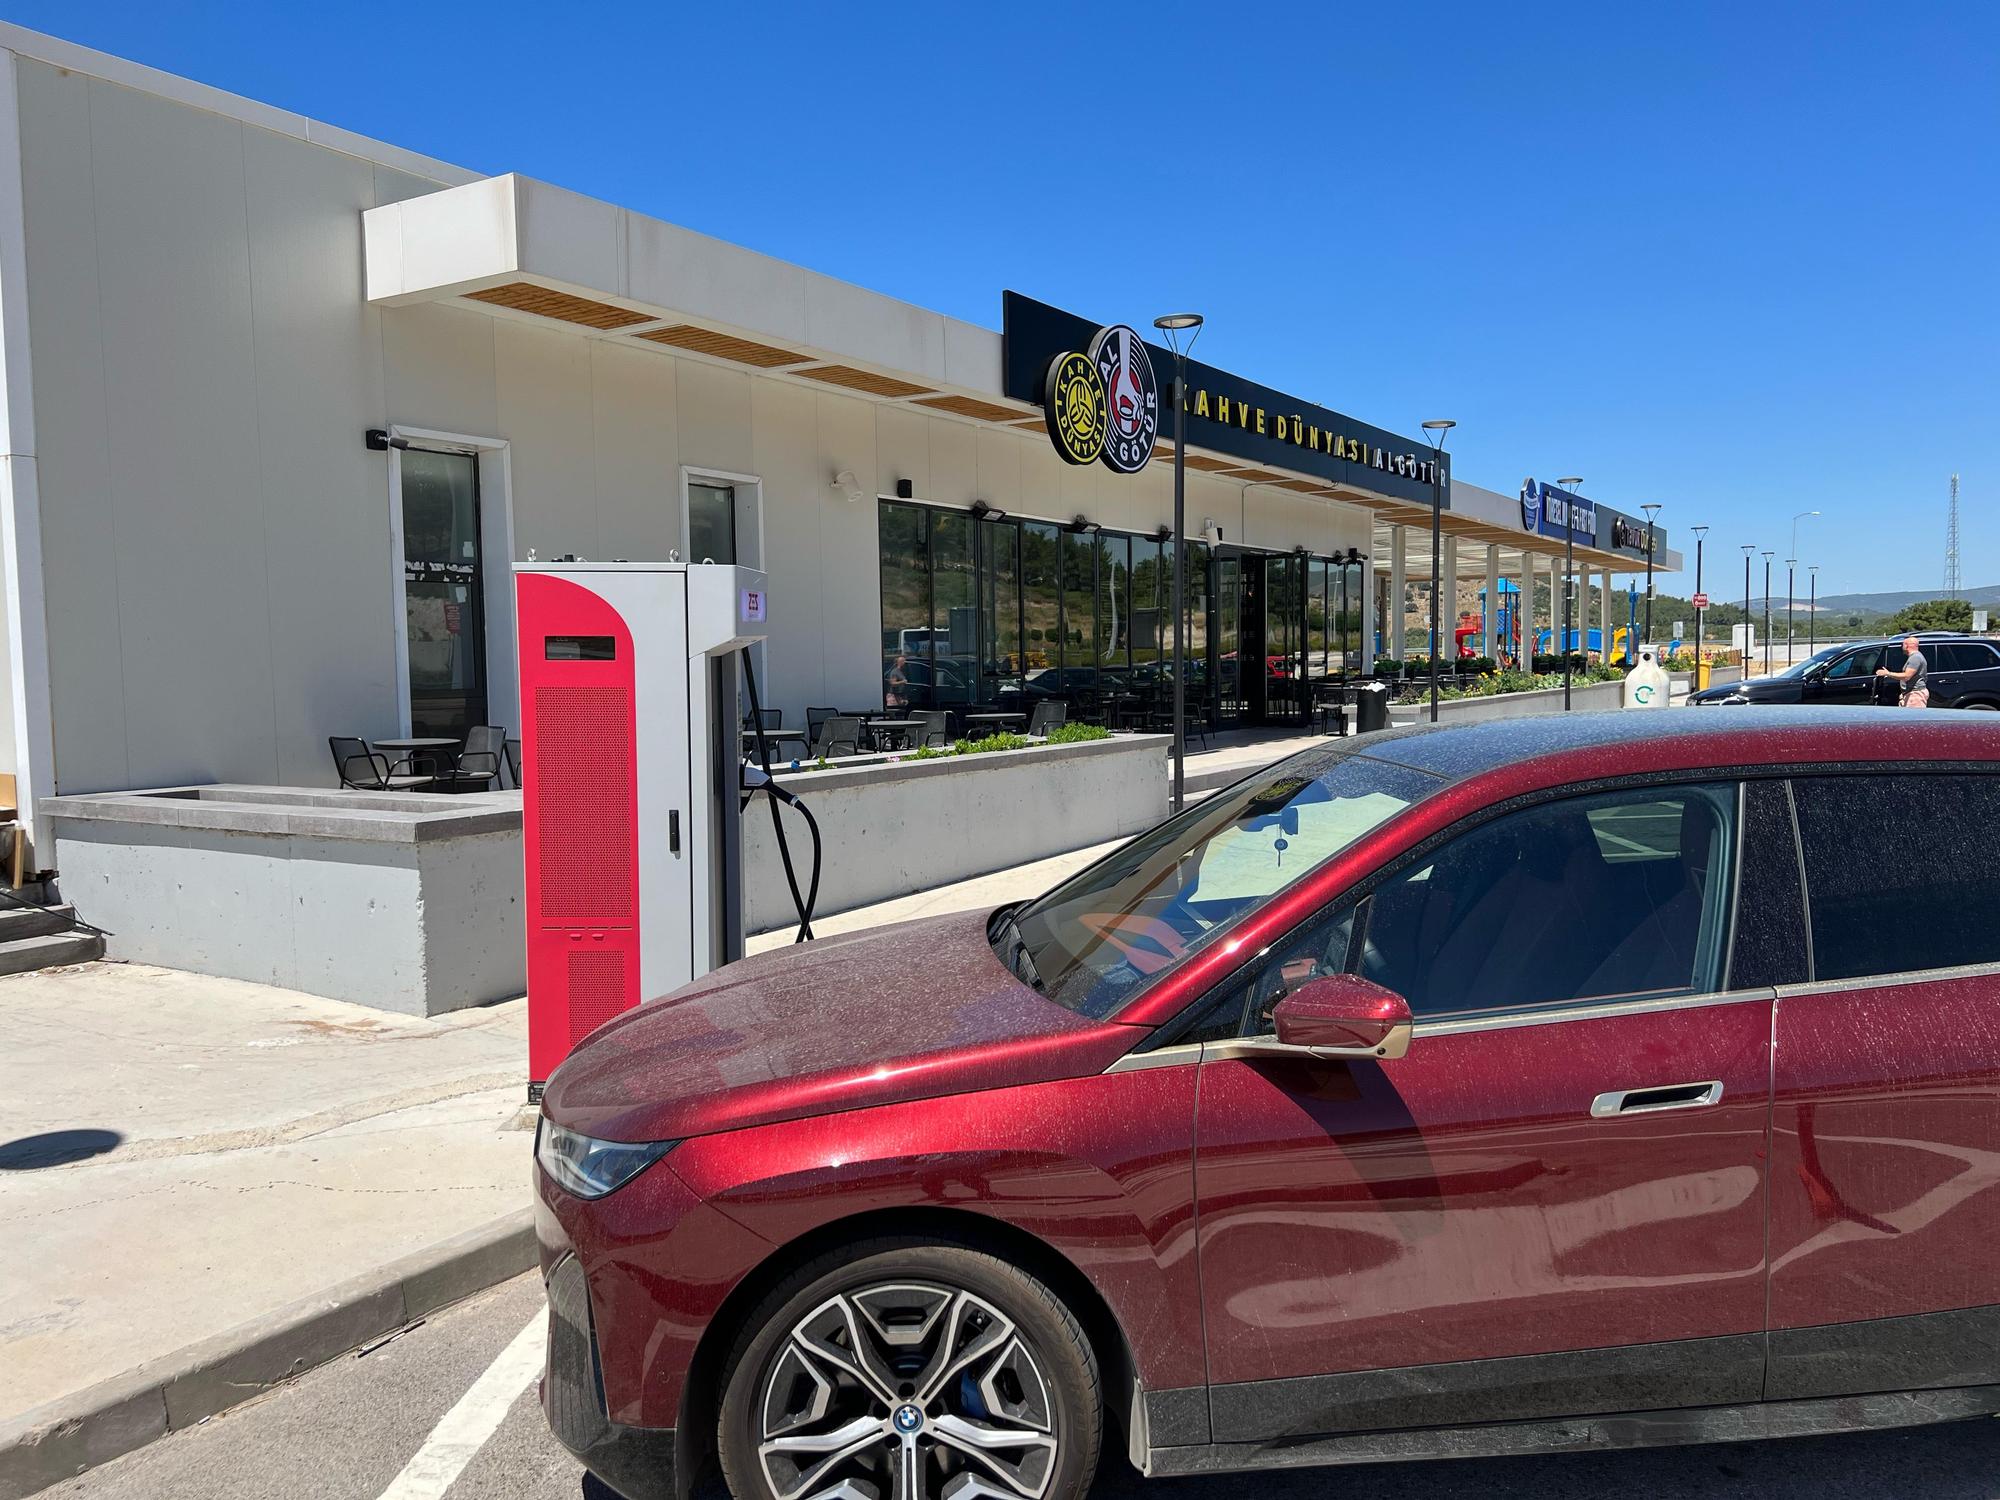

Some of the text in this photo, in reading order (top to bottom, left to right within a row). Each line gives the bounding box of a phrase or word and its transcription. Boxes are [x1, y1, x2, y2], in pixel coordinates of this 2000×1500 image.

[1060, 361, 1103, 456] KAHVE DÜNYASI
[1101, 345, 1156, 462] AL GÖTÜR
[1277, 414, 1367, 465] DÜNYASI
